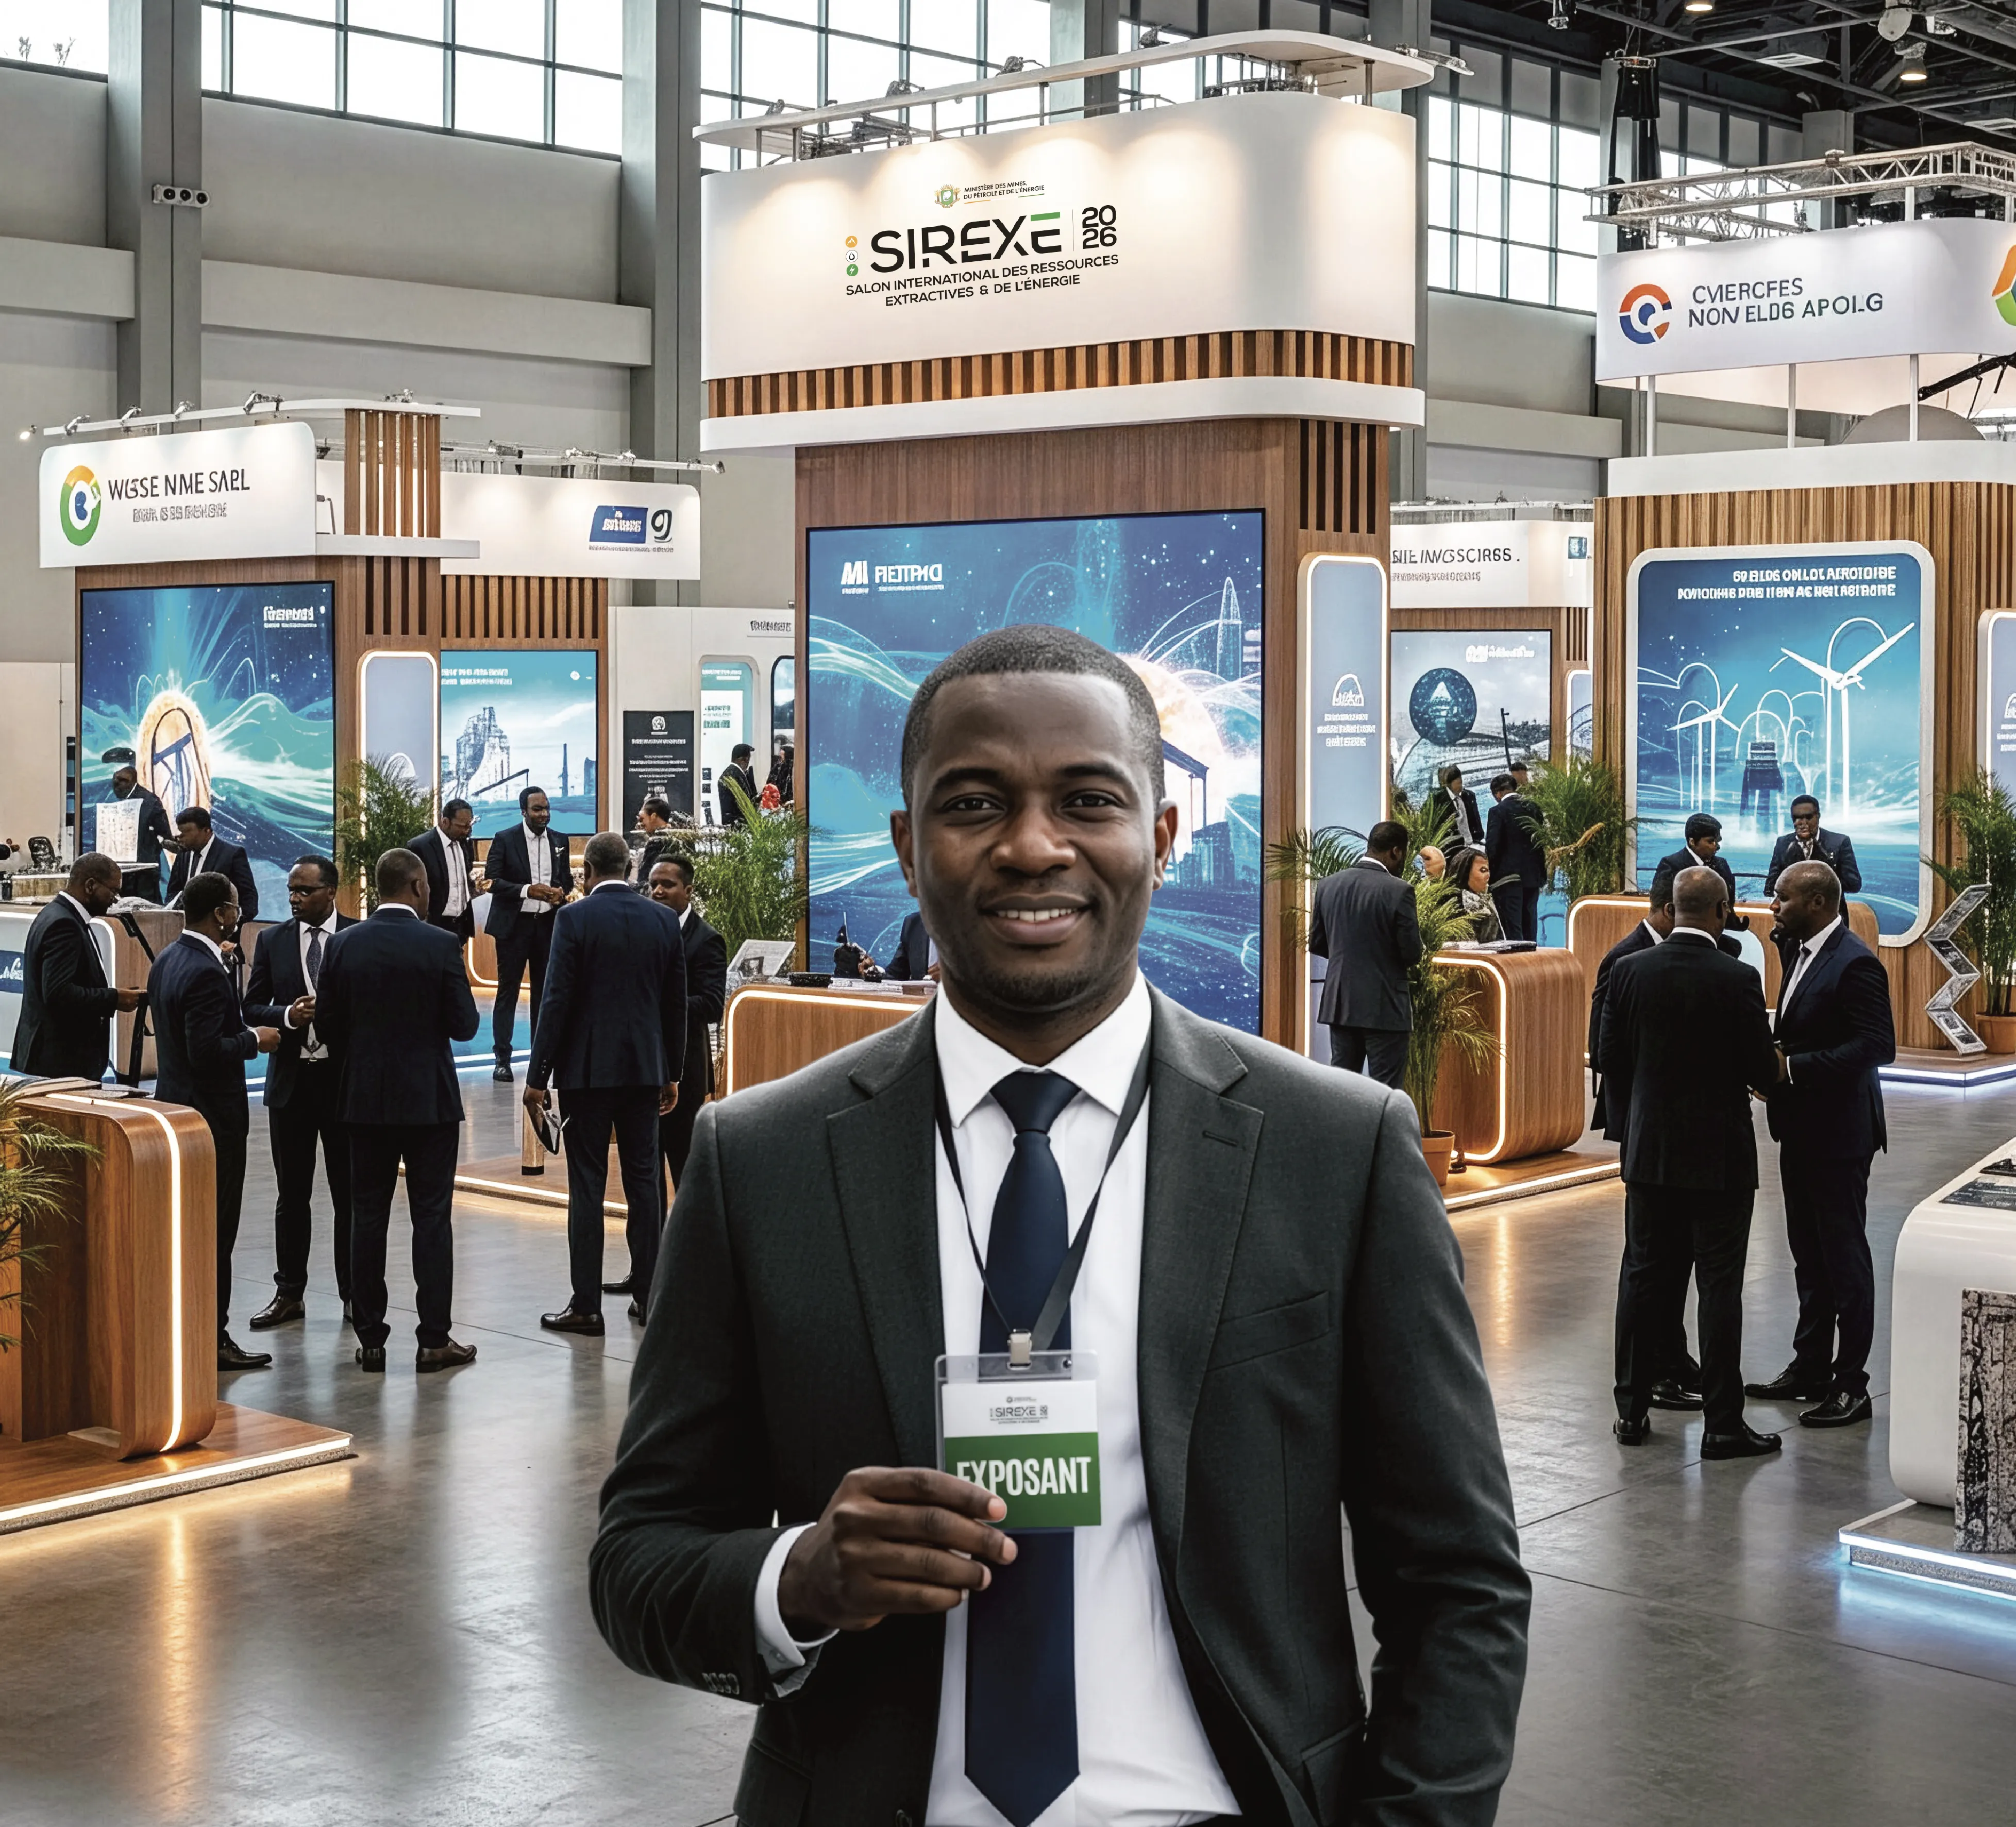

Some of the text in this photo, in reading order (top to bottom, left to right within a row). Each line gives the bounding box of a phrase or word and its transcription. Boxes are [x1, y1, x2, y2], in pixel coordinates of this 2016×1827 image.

[964, 183, 994, 192] MINISTÈRE
[1082, 205, 1116, 228] 20
[870, 212, 1062, 273] SIREXE
[1082, 226, 1117, 249] 26
[846, 254, 1119, 295] SALON INTERNATIONAL DES RESSOURCES
[885, 274, 1081, 307] EXTRACTIVES & DE L'ÉNERGIE
[996, 1406, 1036, 1417] SIREXE
